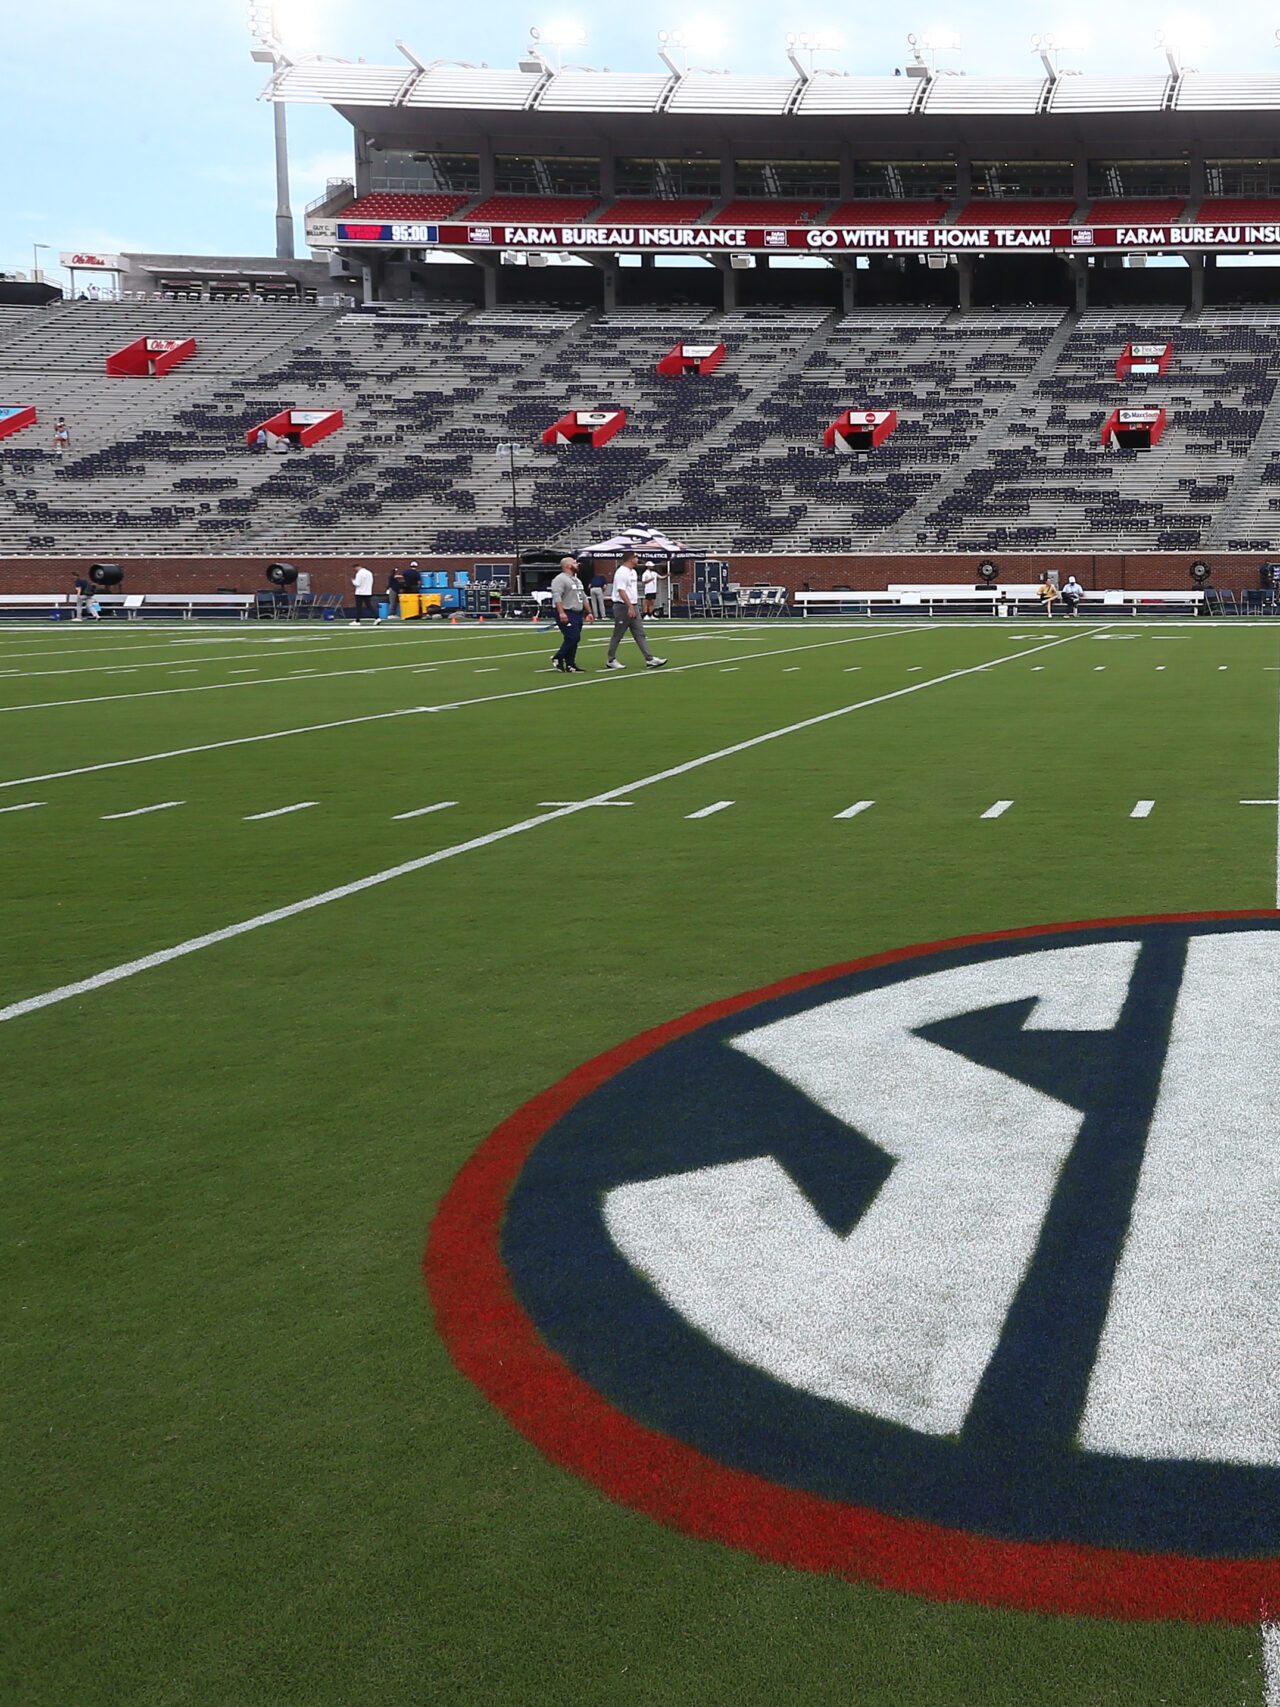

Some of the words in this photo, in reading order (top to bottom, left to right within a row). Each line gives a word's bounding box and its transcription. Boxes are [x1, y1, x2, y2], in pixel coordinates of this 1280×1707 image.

[391, 225, 429, 241] 95:00
[504, 228, 557, 245] FARM
[562, 228, 636, 246] BUREAU
[639, 229, 747, 247] INSURANCE
[806, 230, 838, 247] GO
[842, 230, 891, 247] WITH
[894, 230, 929, 247] THE
[934, 230, 990, 247] HOME
[994, 229, 1051, 246] TEAM!
[1116, 228, 1166, 244] FARM
[1170, 227, 1241, 243] BUREAU
